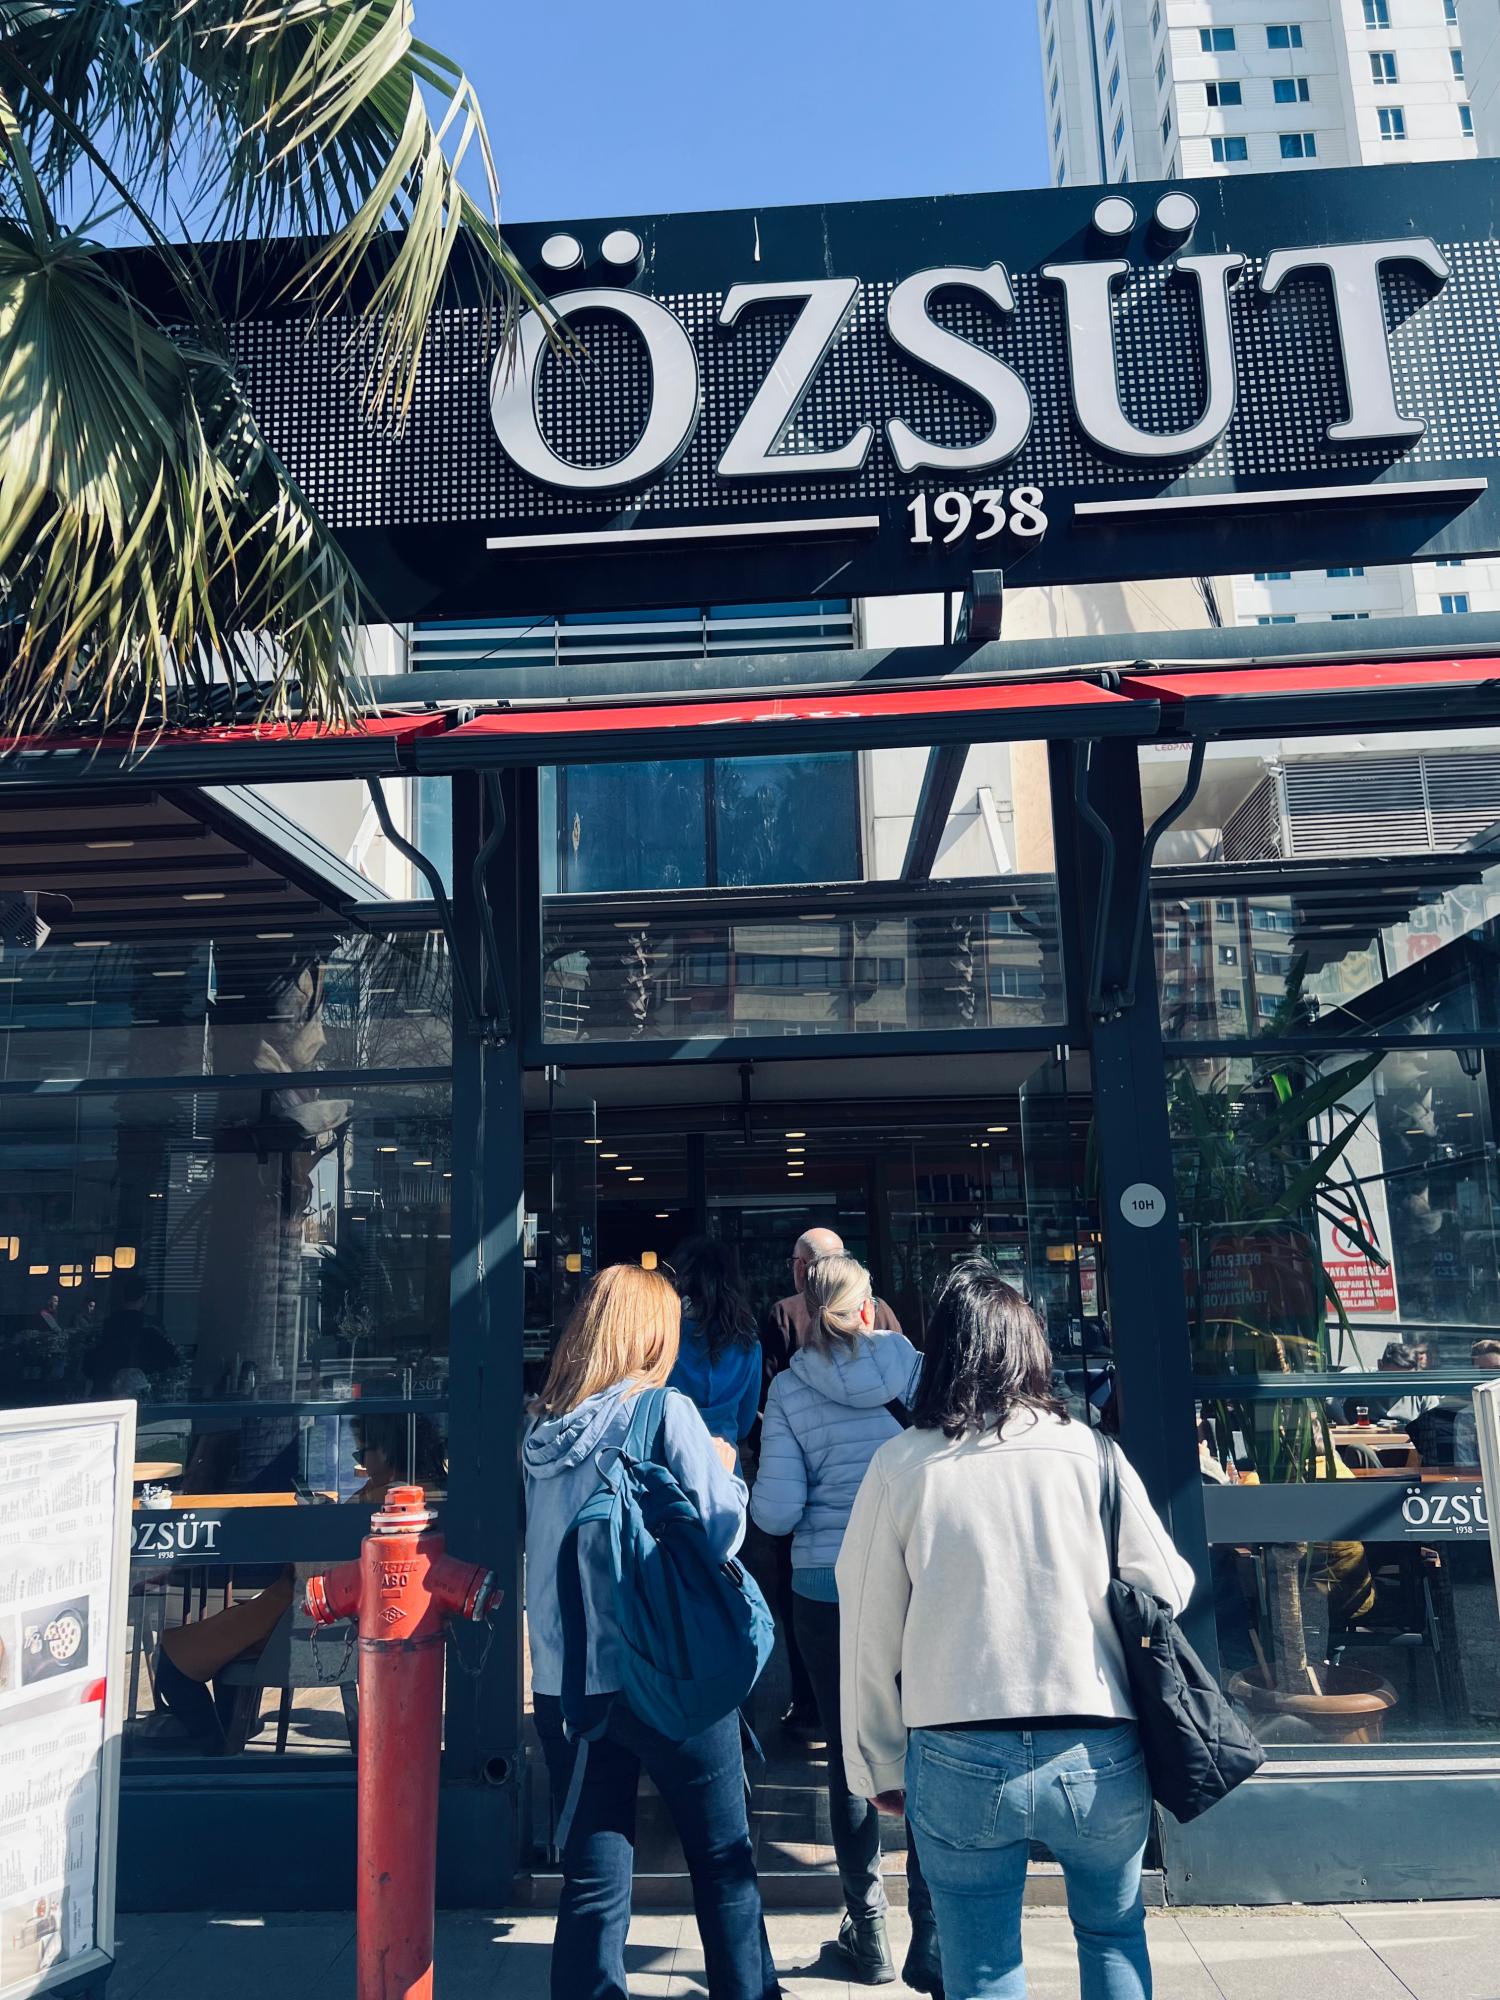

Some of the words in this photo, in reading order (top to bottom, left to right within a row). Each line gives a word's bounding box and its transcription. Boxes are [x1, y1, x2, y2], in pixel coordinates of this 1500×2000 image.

[490, 192, 1450, 488] ÖZSÜT
[907, 487, 1048, 544] 1938
[1132, 1200, 1154, 1210] 10H
[1402, 1487, 1489, 1525] ÖZSÜ
